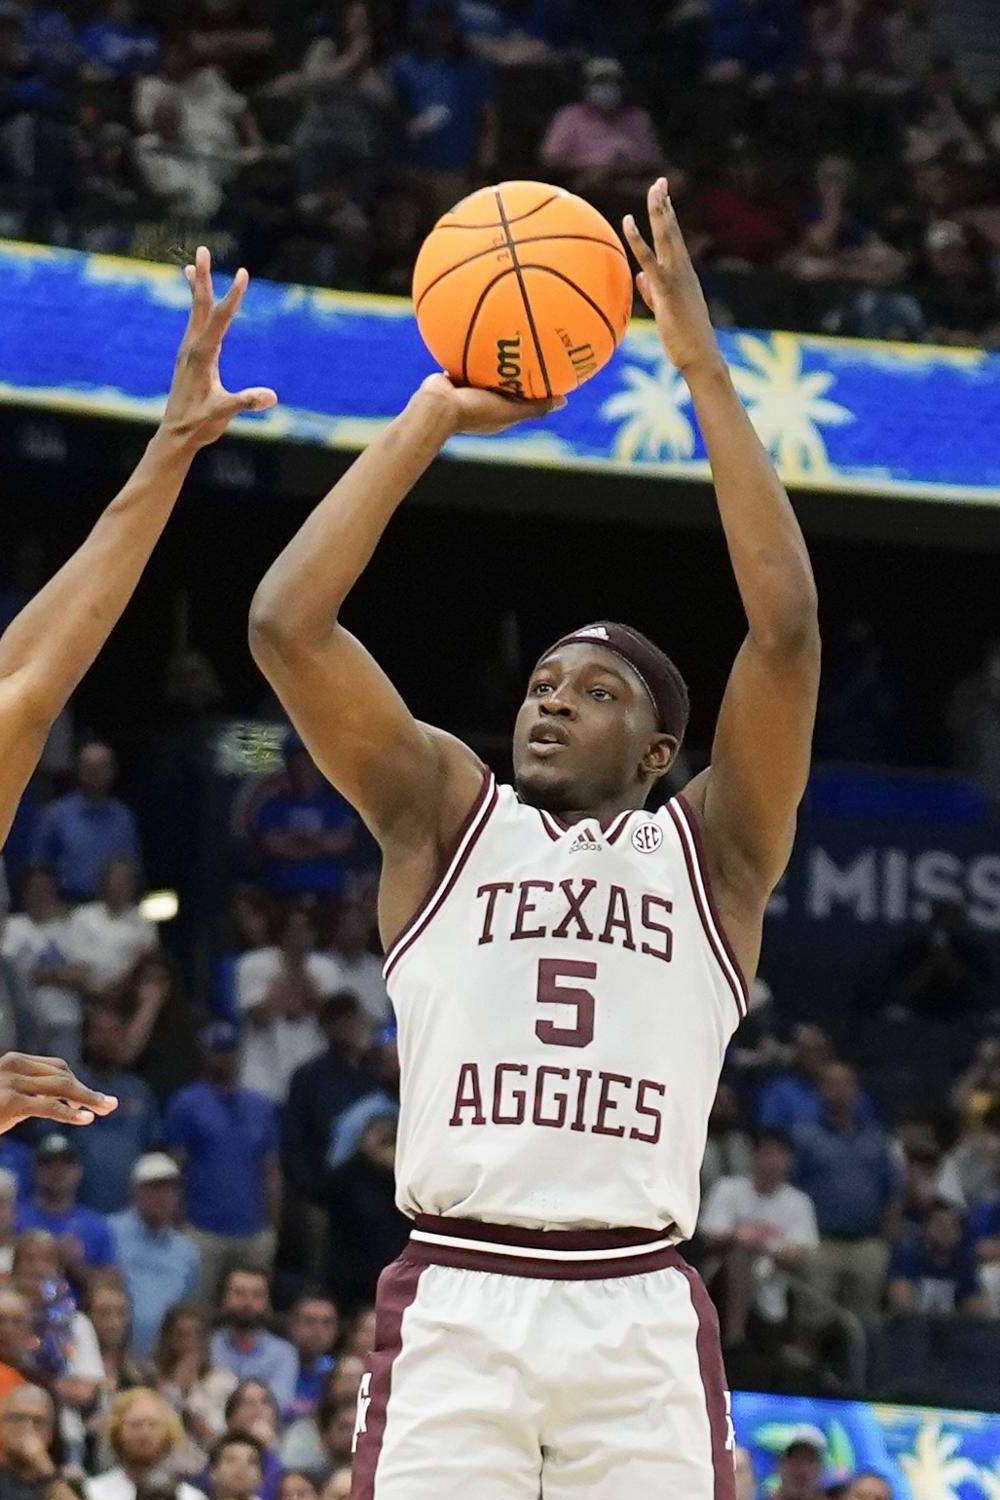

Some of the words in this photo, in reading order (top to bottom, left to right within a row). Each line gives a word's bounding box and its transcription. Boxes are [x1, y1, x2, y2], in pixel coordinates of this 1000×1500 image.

[497, 336, 524, 398] son
[634, 825, 661, 850] SEC
[476, 878, 674, 963] TEXAS
[534, 957, 598, 1049] 5
[449, 1062, 666, 1145] AGGIES
